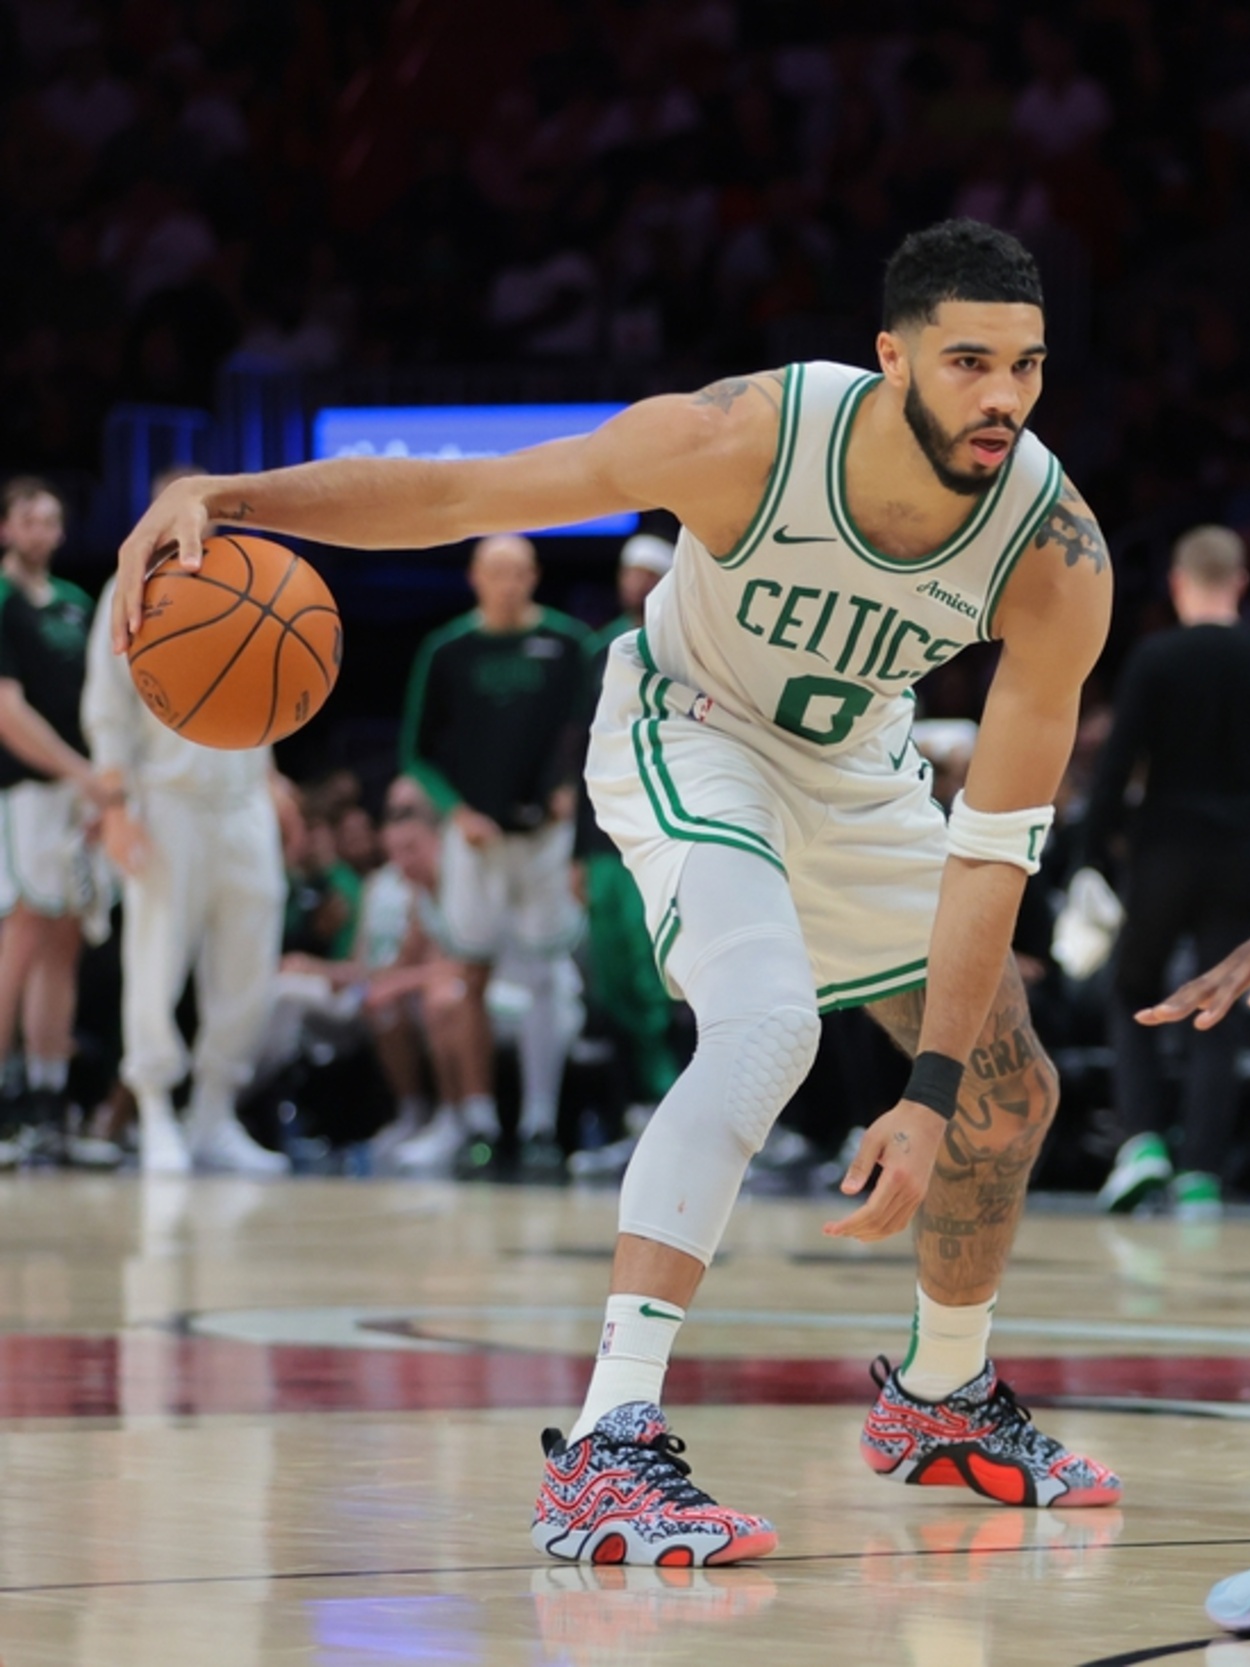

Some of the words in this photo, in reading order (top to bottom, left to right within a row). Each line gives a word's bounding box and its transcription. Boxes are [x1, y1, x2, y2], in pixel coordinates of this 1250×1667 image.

[736, 578, 964, 681] CELTICS
[916, 580, 979, 619] Amica
[773, 674, 875, 746] 0
